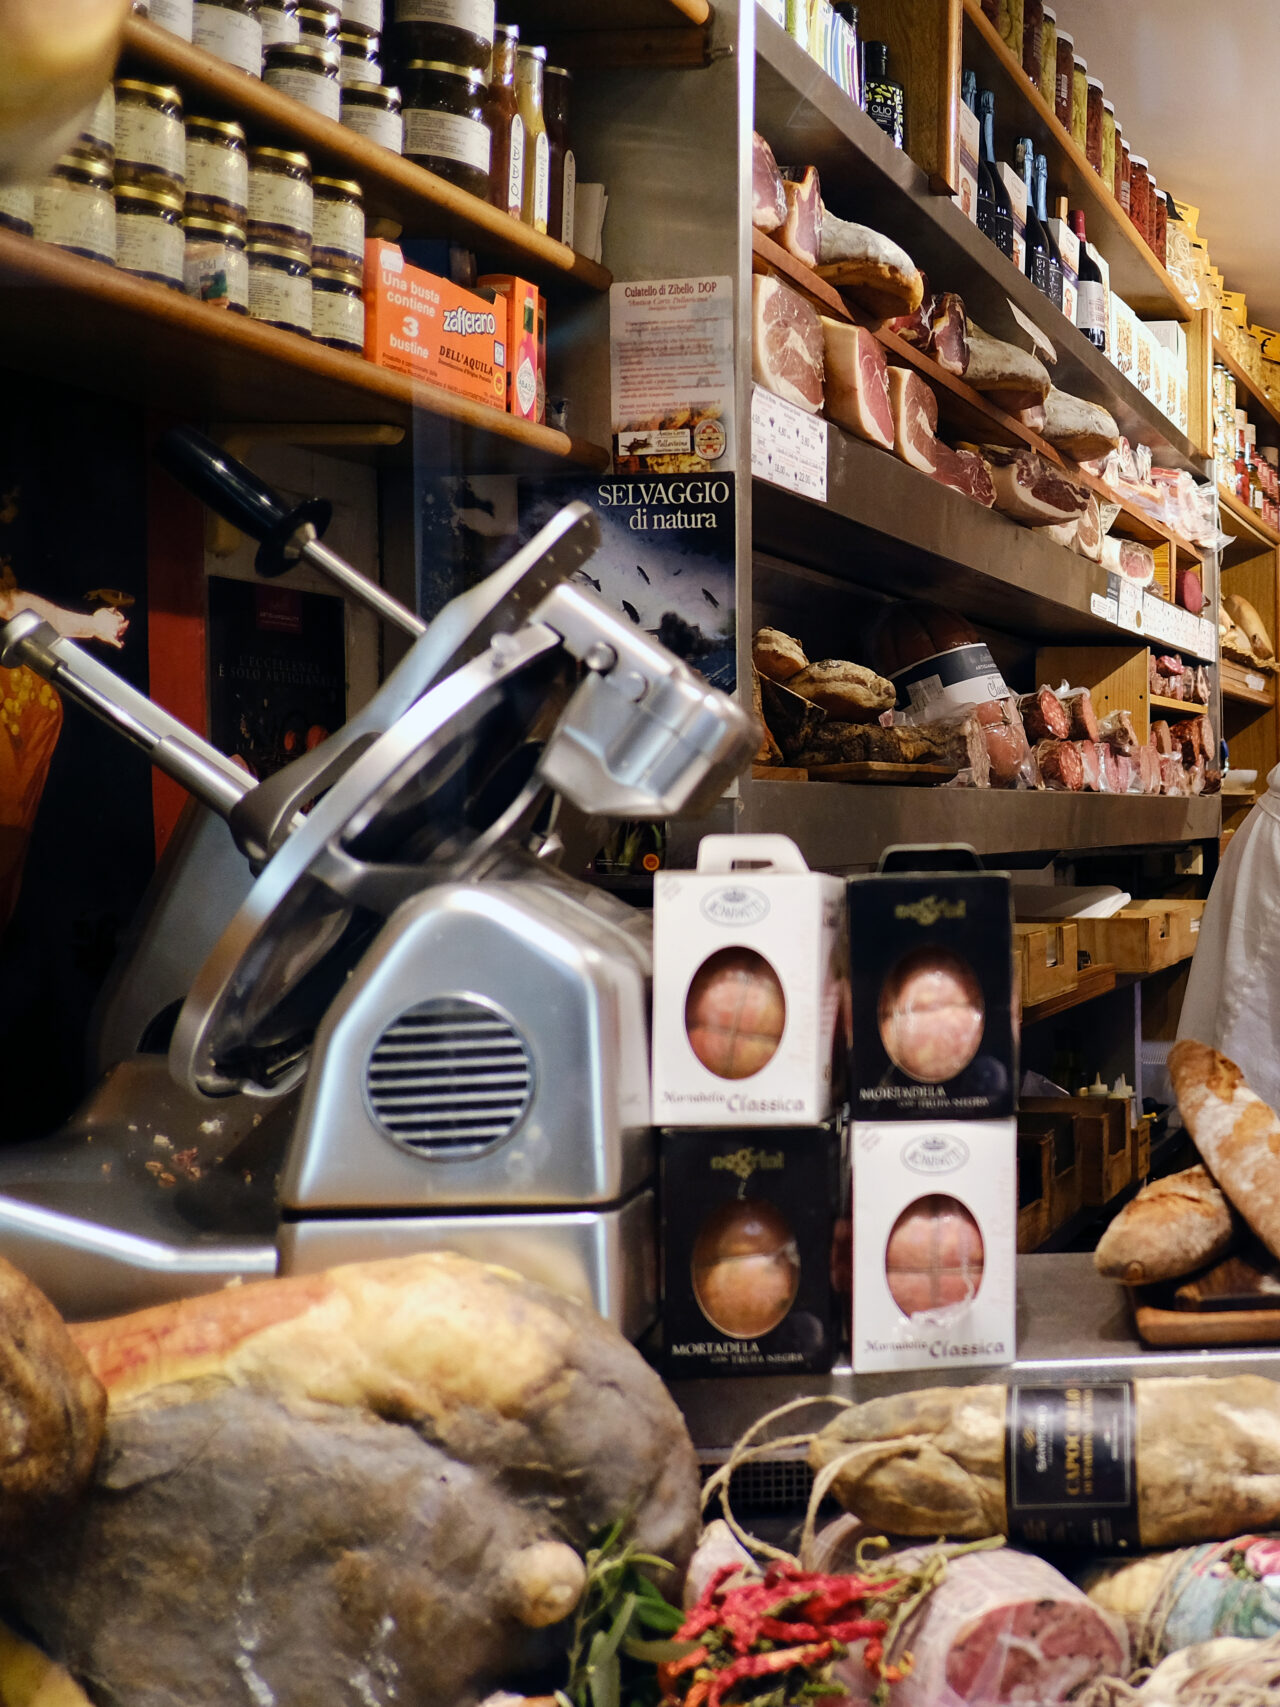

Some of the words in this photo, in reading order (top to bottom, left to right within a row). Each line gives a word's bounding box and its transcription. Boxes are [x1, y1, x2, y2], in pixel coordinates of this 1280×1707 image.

[871, 104, 892, 116] OLIO
[382, 270, 408, 292] Una
[410, 280, 440, 305] busta
[624, 286, 658, 298] Culatello
[658, 284, 667, 296] di
[668, 282, 695, 295] Zibello
[698, 281, 718, 293] DOP
[386, 290, 436, 318] contiene
[402, 315, 419, 338] 3
[442, 306, 496, 337] zafferano
[389, 333, 430, 359] bustine
[439, 345, 494, 377] DELL'AQUILA
[598, 481, 730, 506] SELVAGGIO
[629, 508, 648, 530] di
[653, 510, 717, 530] natura
[230, 665, 261, 681] SOLO
[726, 1094, 806, 1113] Classica
[930, 1340, 1005, 1358] Classica
